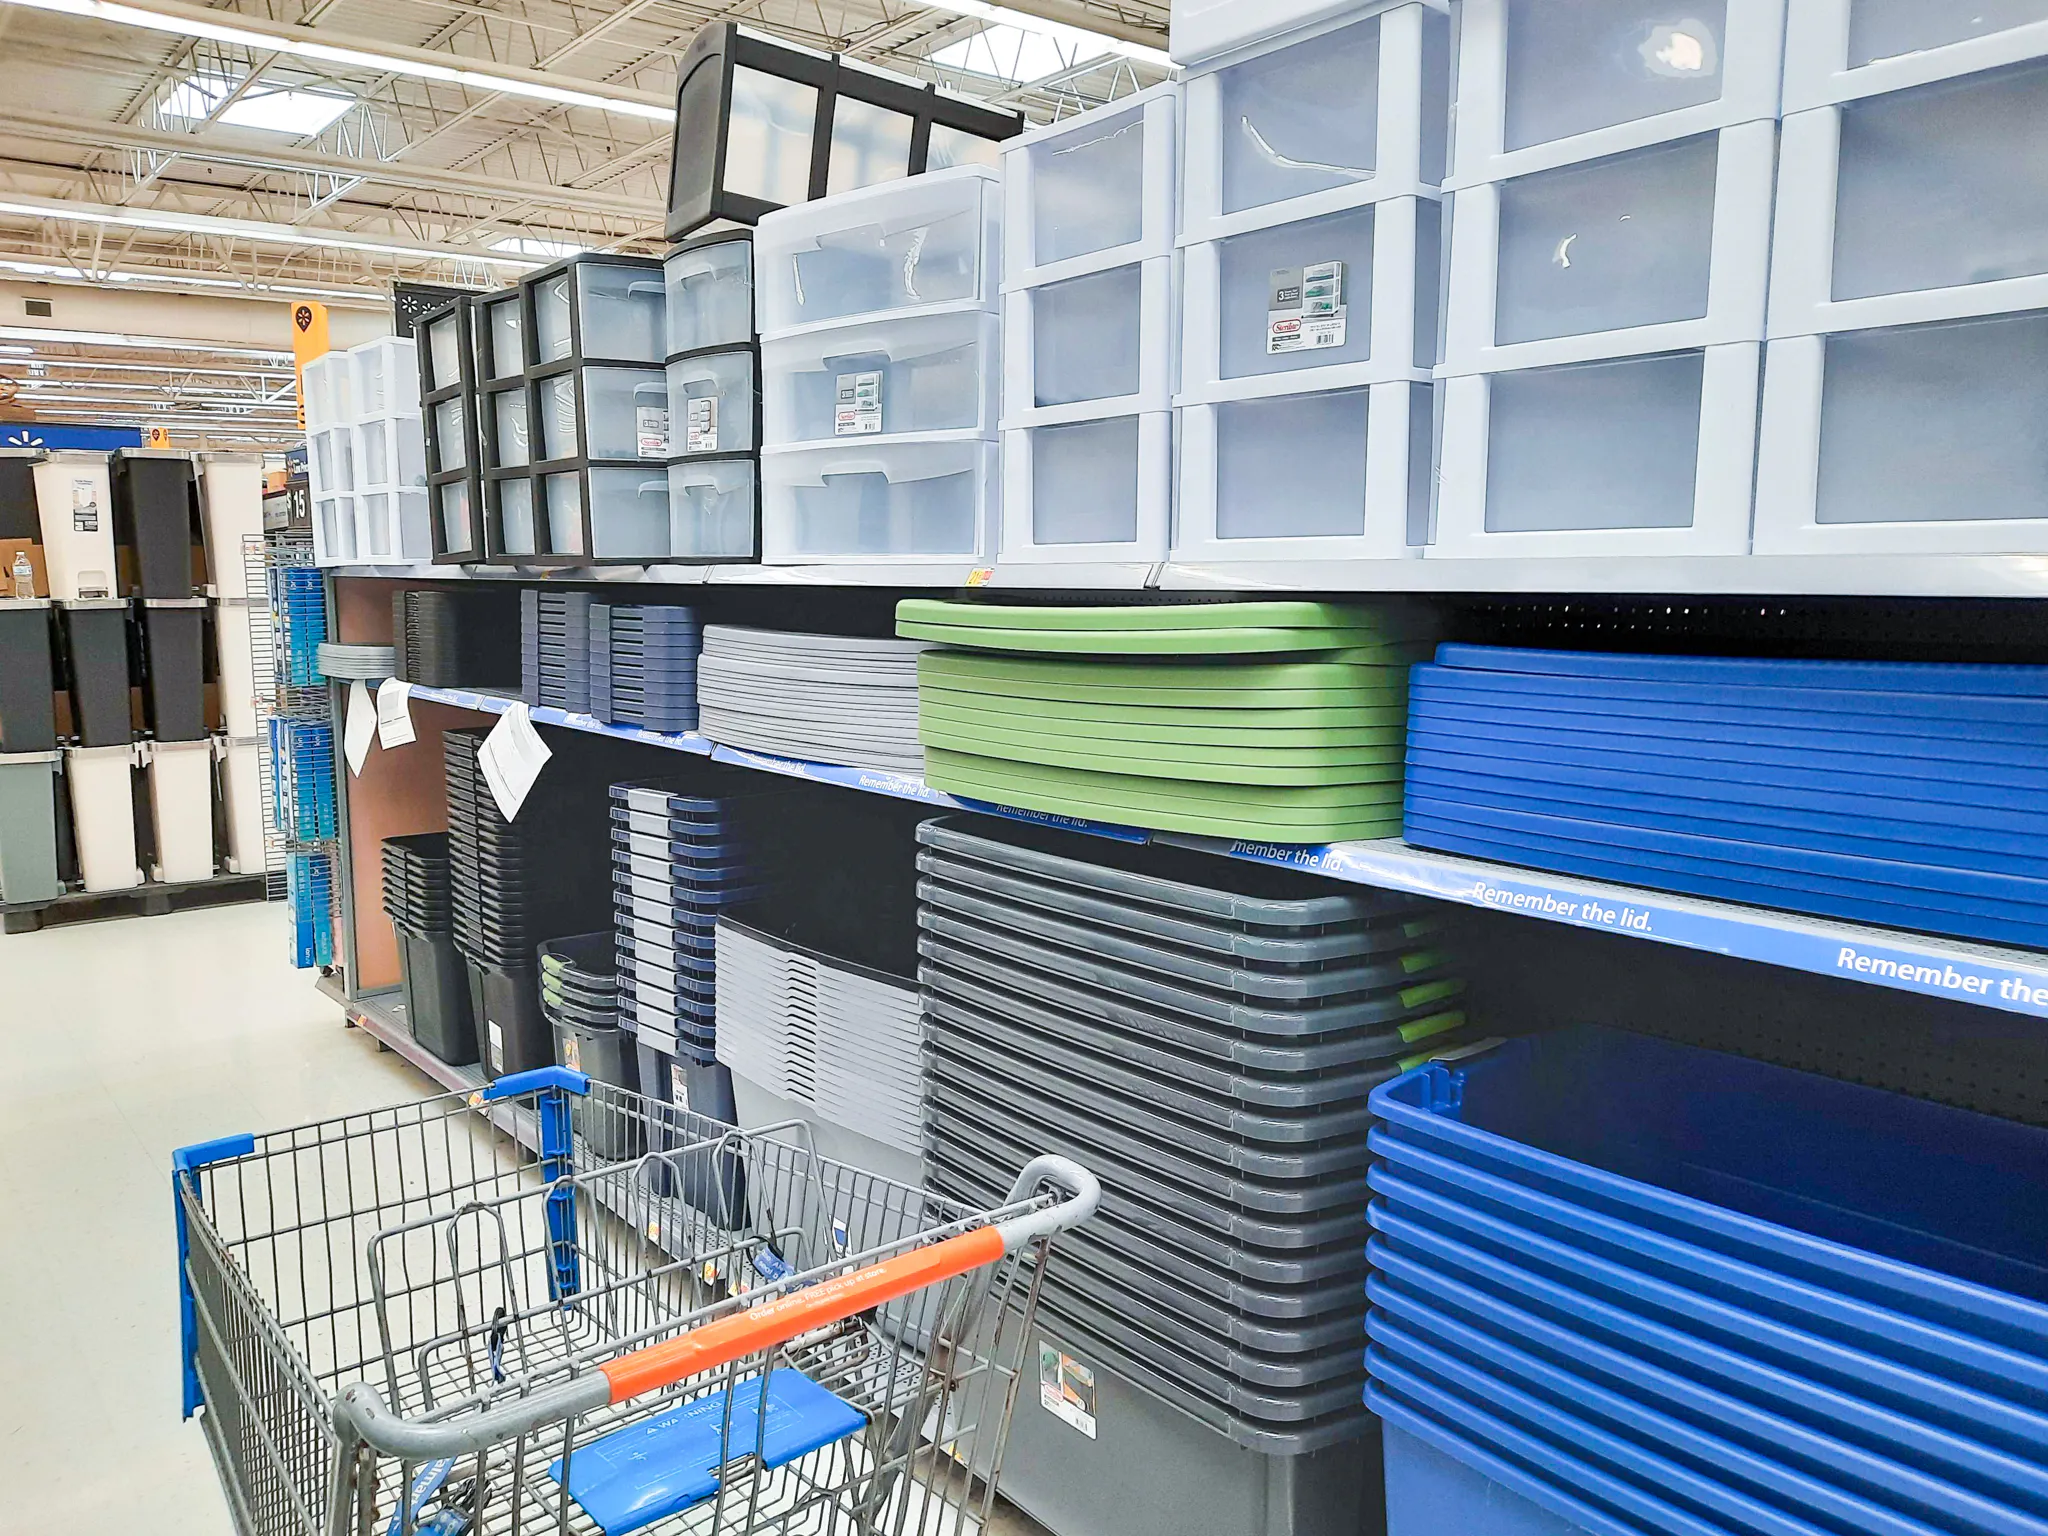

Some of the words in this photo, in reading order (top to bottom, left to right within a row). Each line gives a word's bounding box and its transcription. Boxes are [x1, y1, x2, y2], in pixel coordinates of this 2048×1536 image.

[858, 775, 903, 793] Remember
[903, 783, 916, 795] the
[1230, 840, 1292, 861] member
[1293, 849, 1319, 867] the
[1321, 853, 1344, 872] lid.
[1472, 881, 1579, 916] Remember
[1581, 902, 1616, 924] the
[1620, 908, 1652, 932] lid.
[1837, 947, 1994, 995] Remember
[2000, 977, 2048, 1006] the
[750, 1307, 775, 1321] Order
[805, 1288, 827, 1302] FREE
[826, 1282, 844, 1296] pick
[844, 1278, 855, 1289] up
[657, 1401, 724, 1429] WANING
